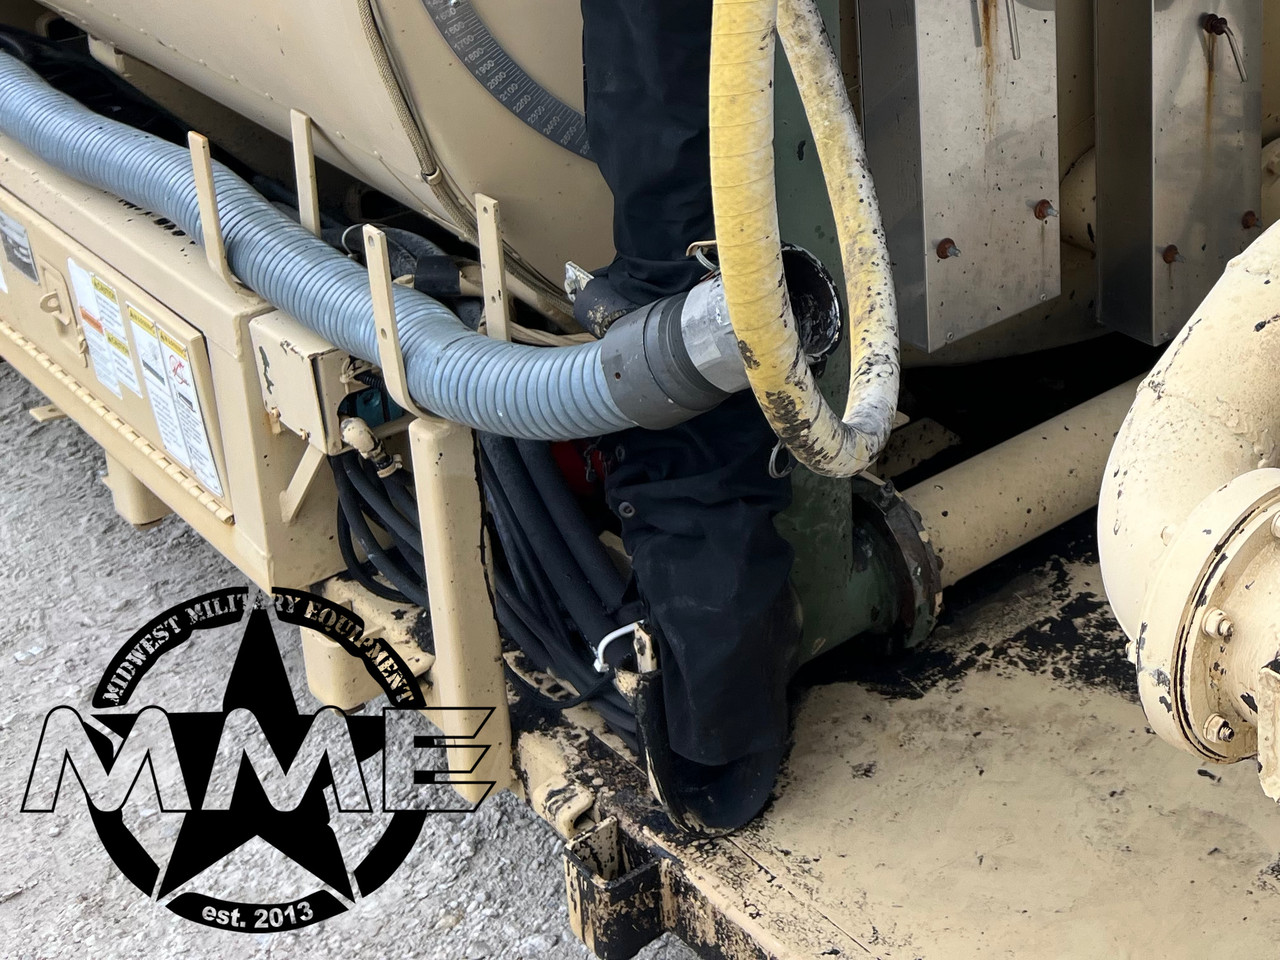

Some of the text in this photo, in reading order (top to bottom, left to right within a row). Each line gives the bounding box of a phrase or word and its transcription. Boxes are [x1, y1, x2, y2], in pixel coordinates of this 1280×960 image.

[453, 34, 475, 50] 1700
[464, 47, 485, 63] 1800
[475, 59, 495, 76] 1900
[487, 71, 507, 89] 2000
[499, 83, 519, 102] 2100
[512, 94, 532, 113] 2200
[527, 105, 545, 124] 2300
[543, 115, 561, 135] 2400
